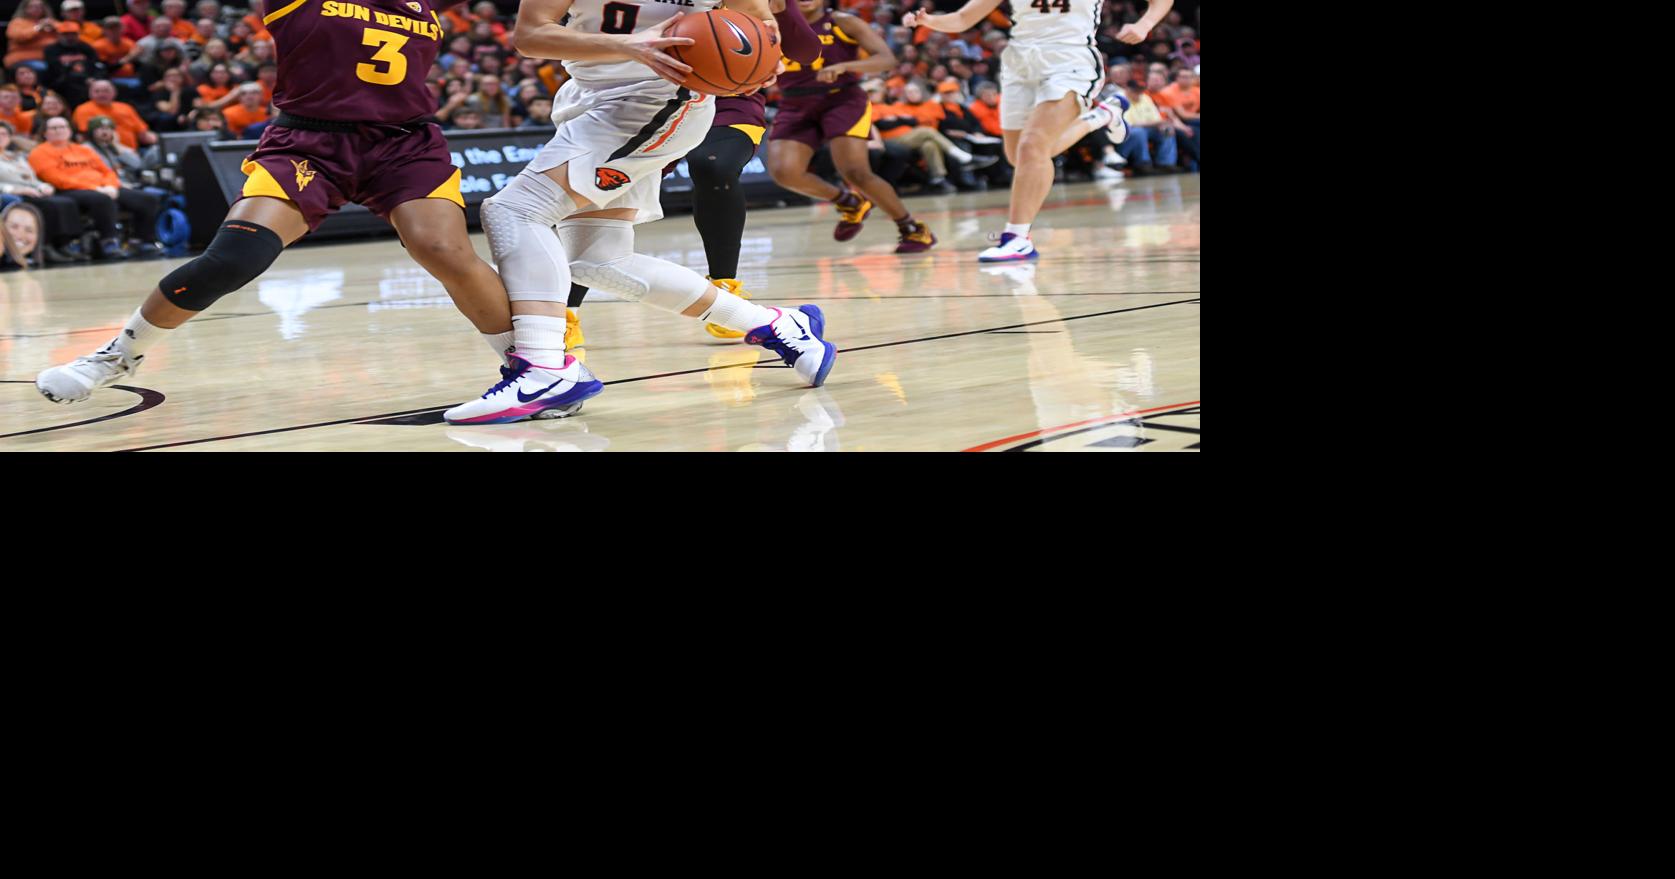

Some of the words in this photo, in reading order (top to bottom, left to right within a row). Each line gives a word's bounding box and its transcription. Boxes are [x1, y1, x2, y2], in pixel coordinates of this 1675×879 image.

[321, 1, 370, 22] SUN
[373, 10, 438, 41] DEVILS
[601, 1, 640, 34] 0
[1030, 0, 1071, 13] 44
[356, 27, 410, 86] 3
